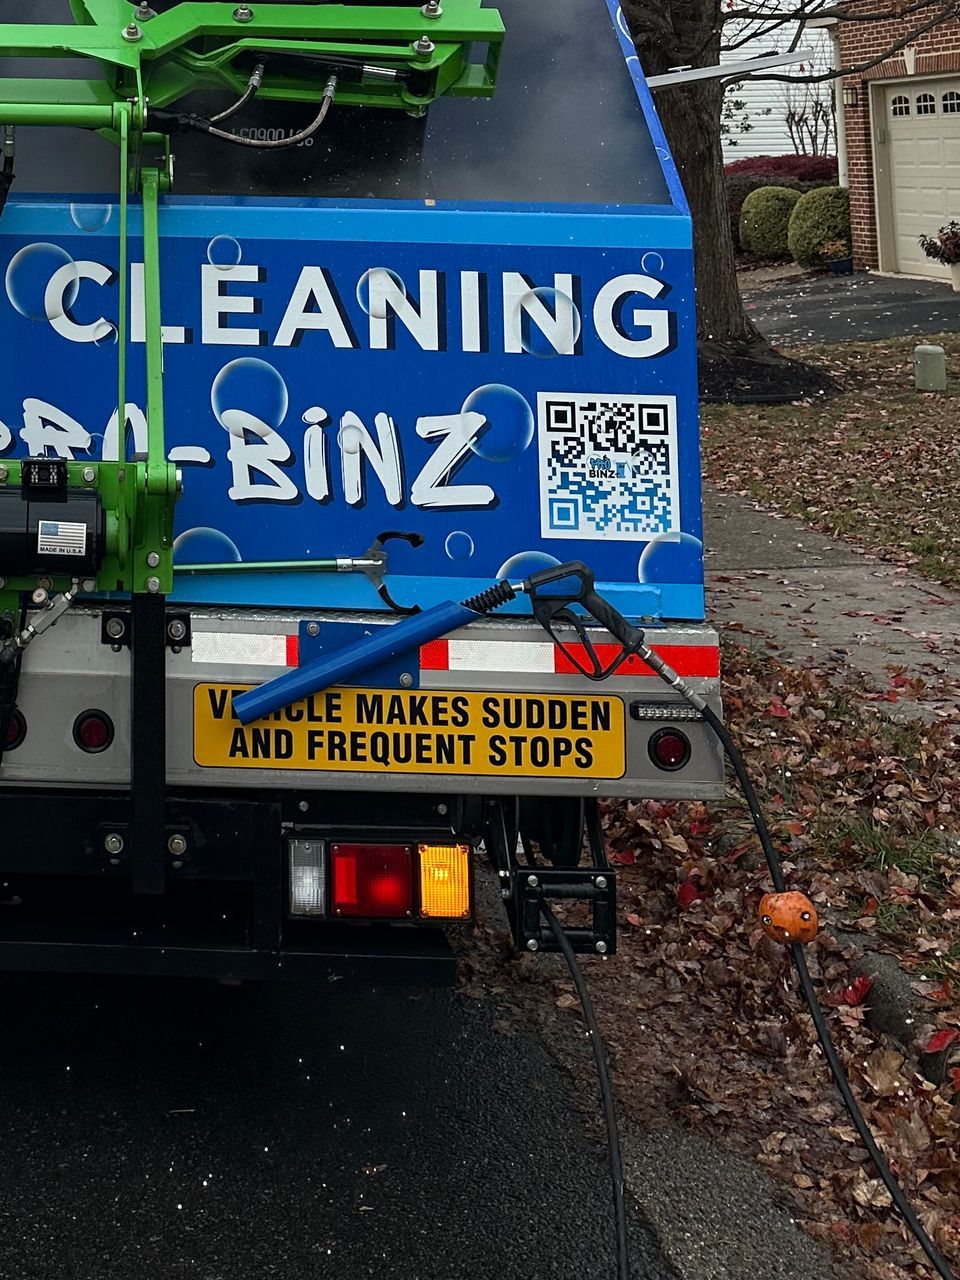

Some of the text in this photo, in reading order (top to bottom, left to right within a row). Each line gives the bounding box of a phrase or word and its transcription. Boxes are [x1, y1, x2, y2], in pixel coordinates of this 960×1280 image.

[44, 259, 670, 358] CLEANING
[589, 470, 615, 478] BINZ
[208, 688, 611, 732] VCLE MAKES SUDDEN
[229, 727, 593, 769] AND FREQUENT STOPS
